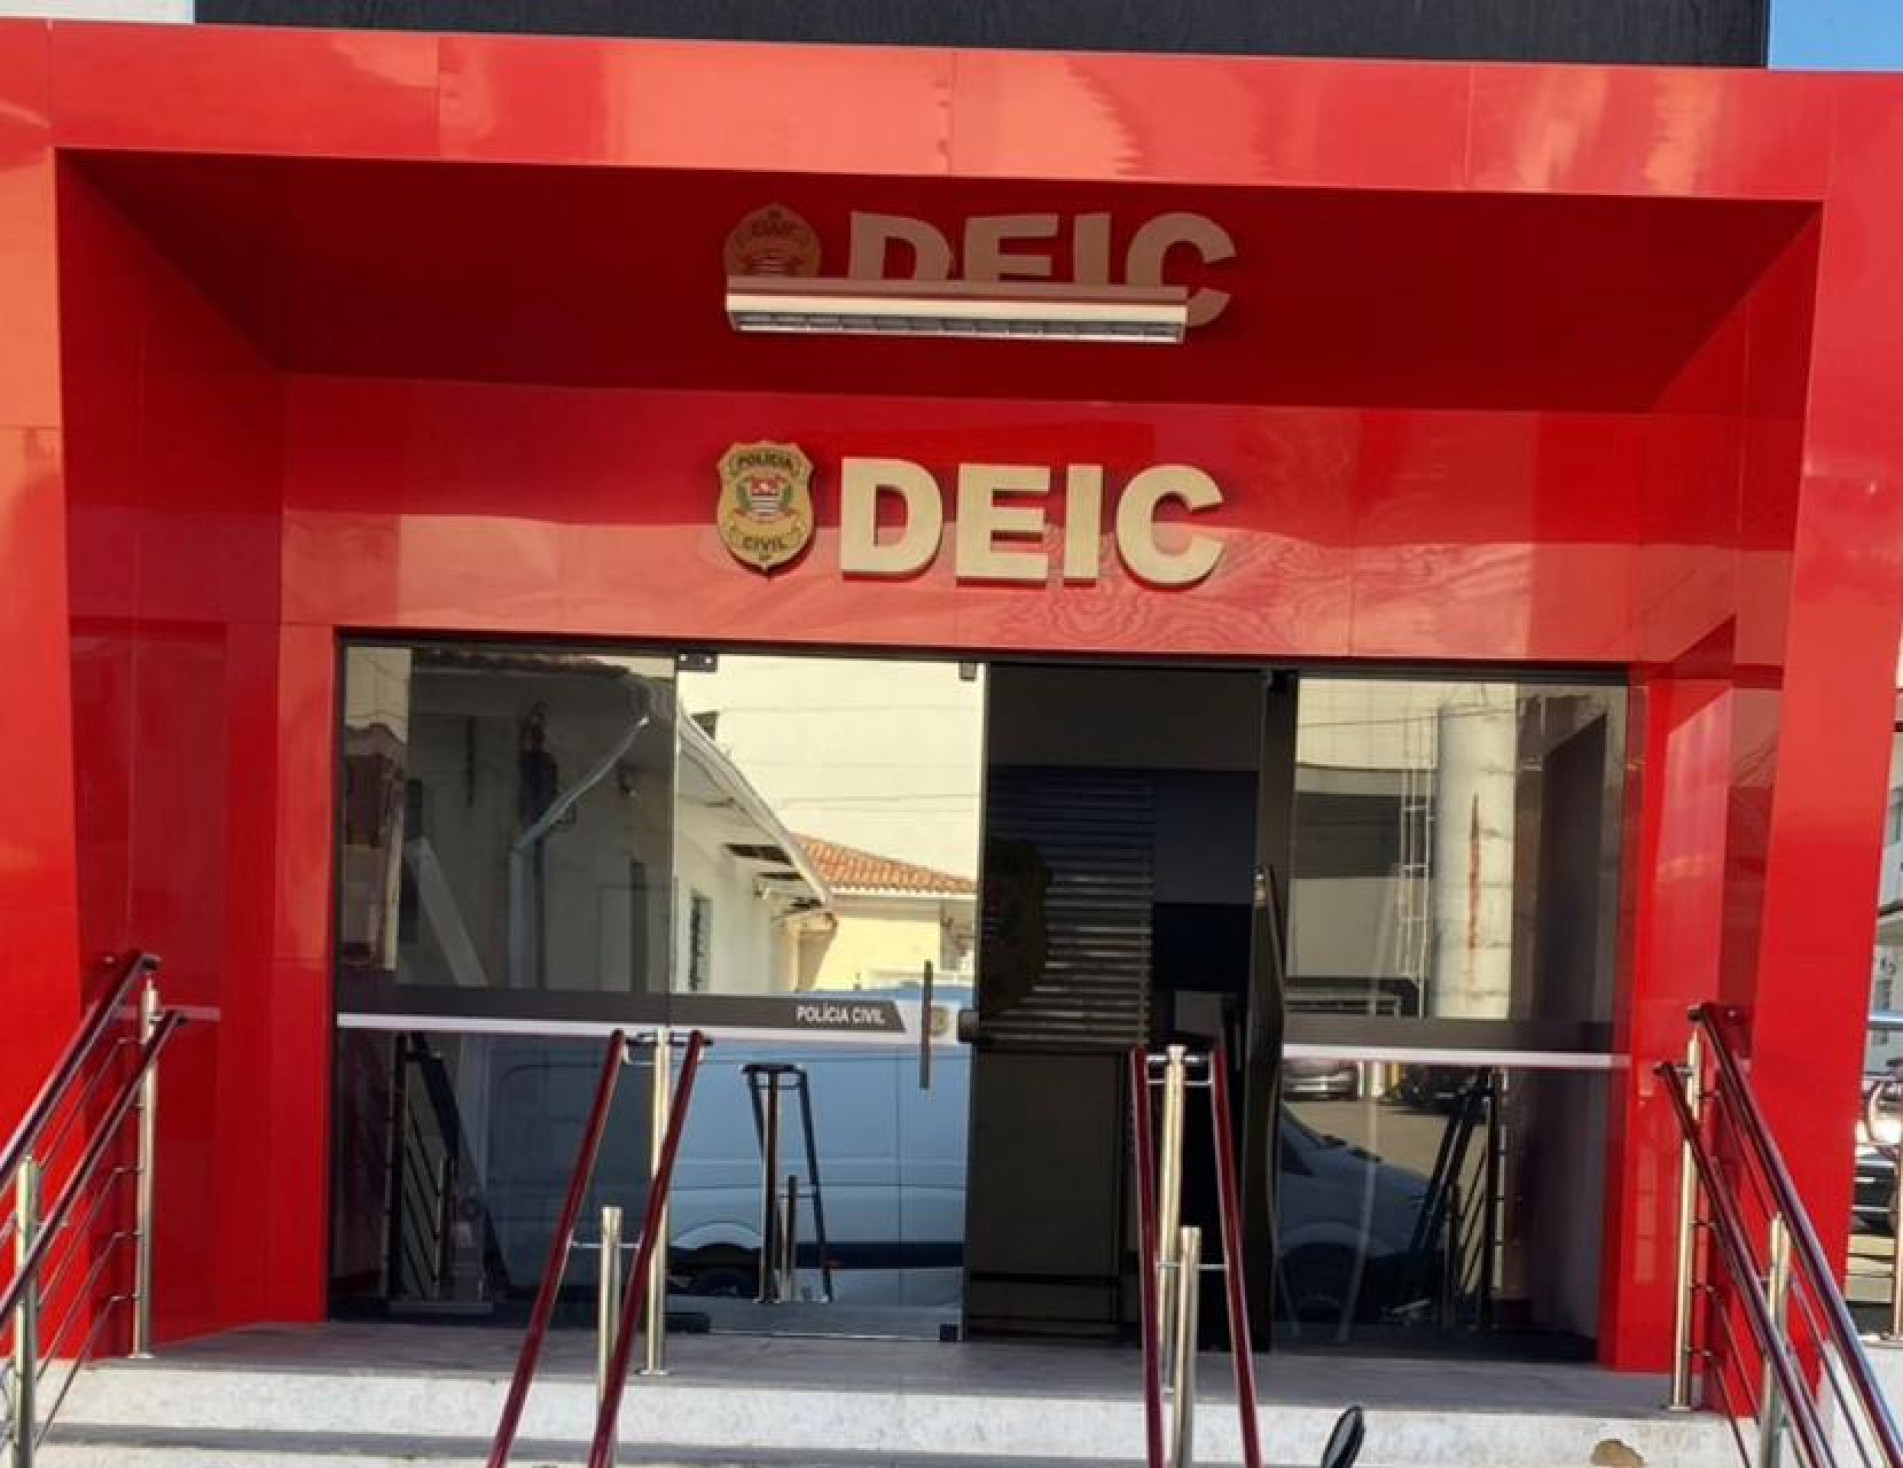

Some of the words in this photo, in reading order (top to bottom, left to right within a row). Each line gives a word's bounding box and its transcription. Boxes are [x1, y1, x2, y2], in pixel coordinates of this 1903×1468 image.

[840, 457, 1224, 587] DEIC
[797, 1003, 849, 1023] POLÍCIA
[852, 1006, 886, 1024] CIVIL
